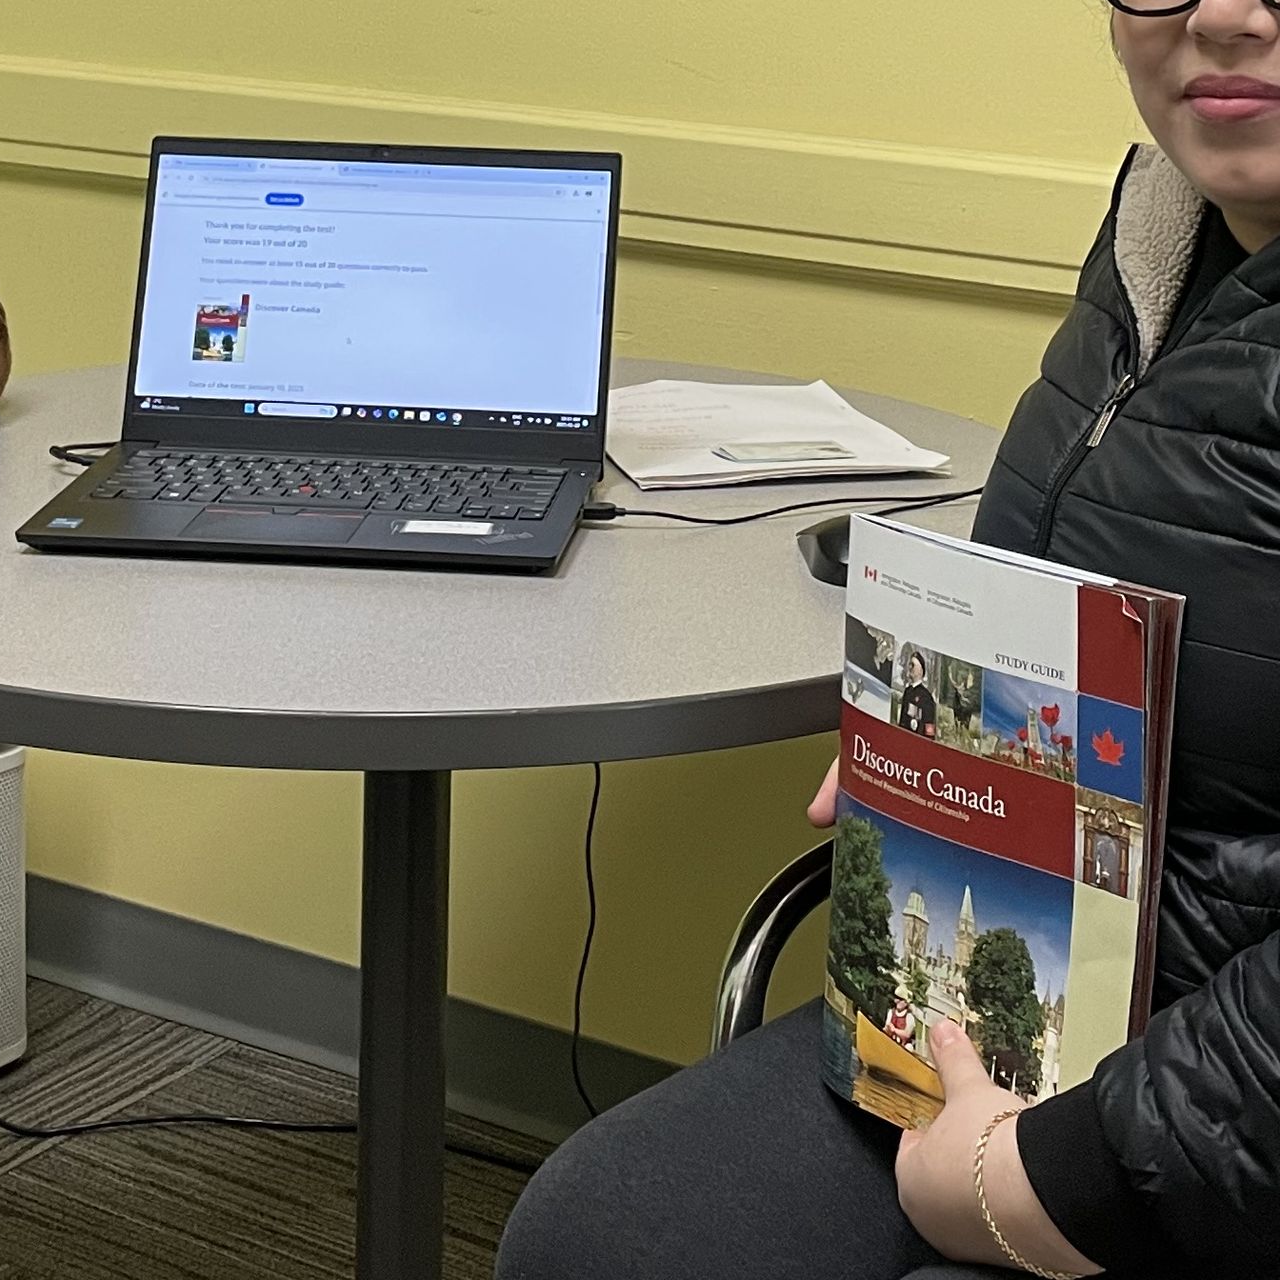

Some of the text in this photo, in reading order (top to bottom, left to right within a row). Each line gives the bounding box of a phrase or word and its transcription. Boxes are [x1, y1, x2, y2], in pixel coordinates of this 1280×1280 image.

[206, 221, 228, 230] Thank
[230, 223, 245, 231] you
[246, 223, 258, 231] for
[259, 223, 301, 233] completing
[303, 225, 315, 233] the
[204, 237, 221, 245] Your
[262, 239, 272, 247] 19
[287, 240, 296, 248] of
[297, 240, 308, 248] 20
[255, 304, 321, 314] Discover Canada
[994, 653, 1065, 681] STUDY GUIDE
[852, 734, 1007, 818] Discover Canada
[926, 800, 934, 809] of
